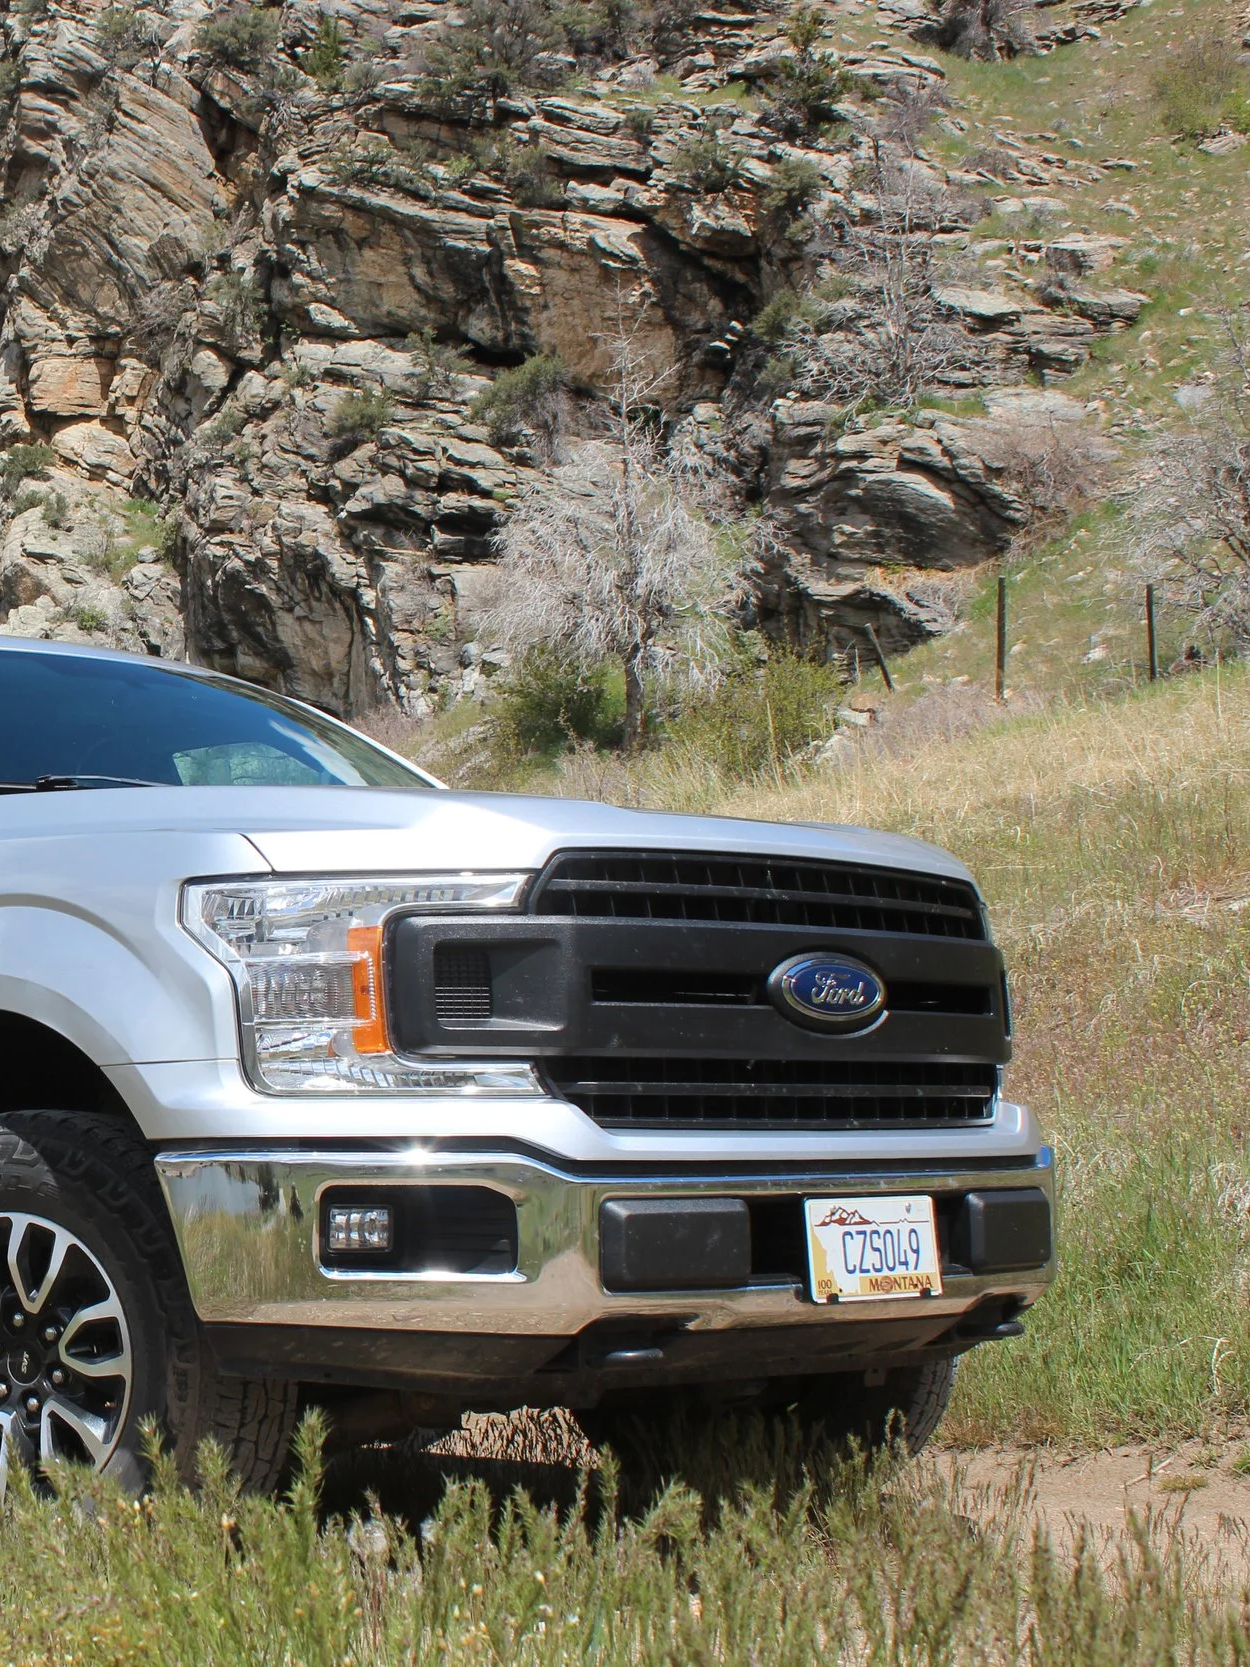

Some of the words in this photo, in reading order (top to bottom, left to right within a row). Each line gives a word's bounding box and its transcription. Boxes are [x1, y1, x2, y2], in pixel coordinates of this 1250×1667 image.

[811, 971, 865, 1005] Ford
[842, 1228, 920, 1275] CZS049
[817, 1279, 833, 1290] 100
[869, 1275, 934, 1293] MONTANA
[21, 1351, 30, 1374] SVT
